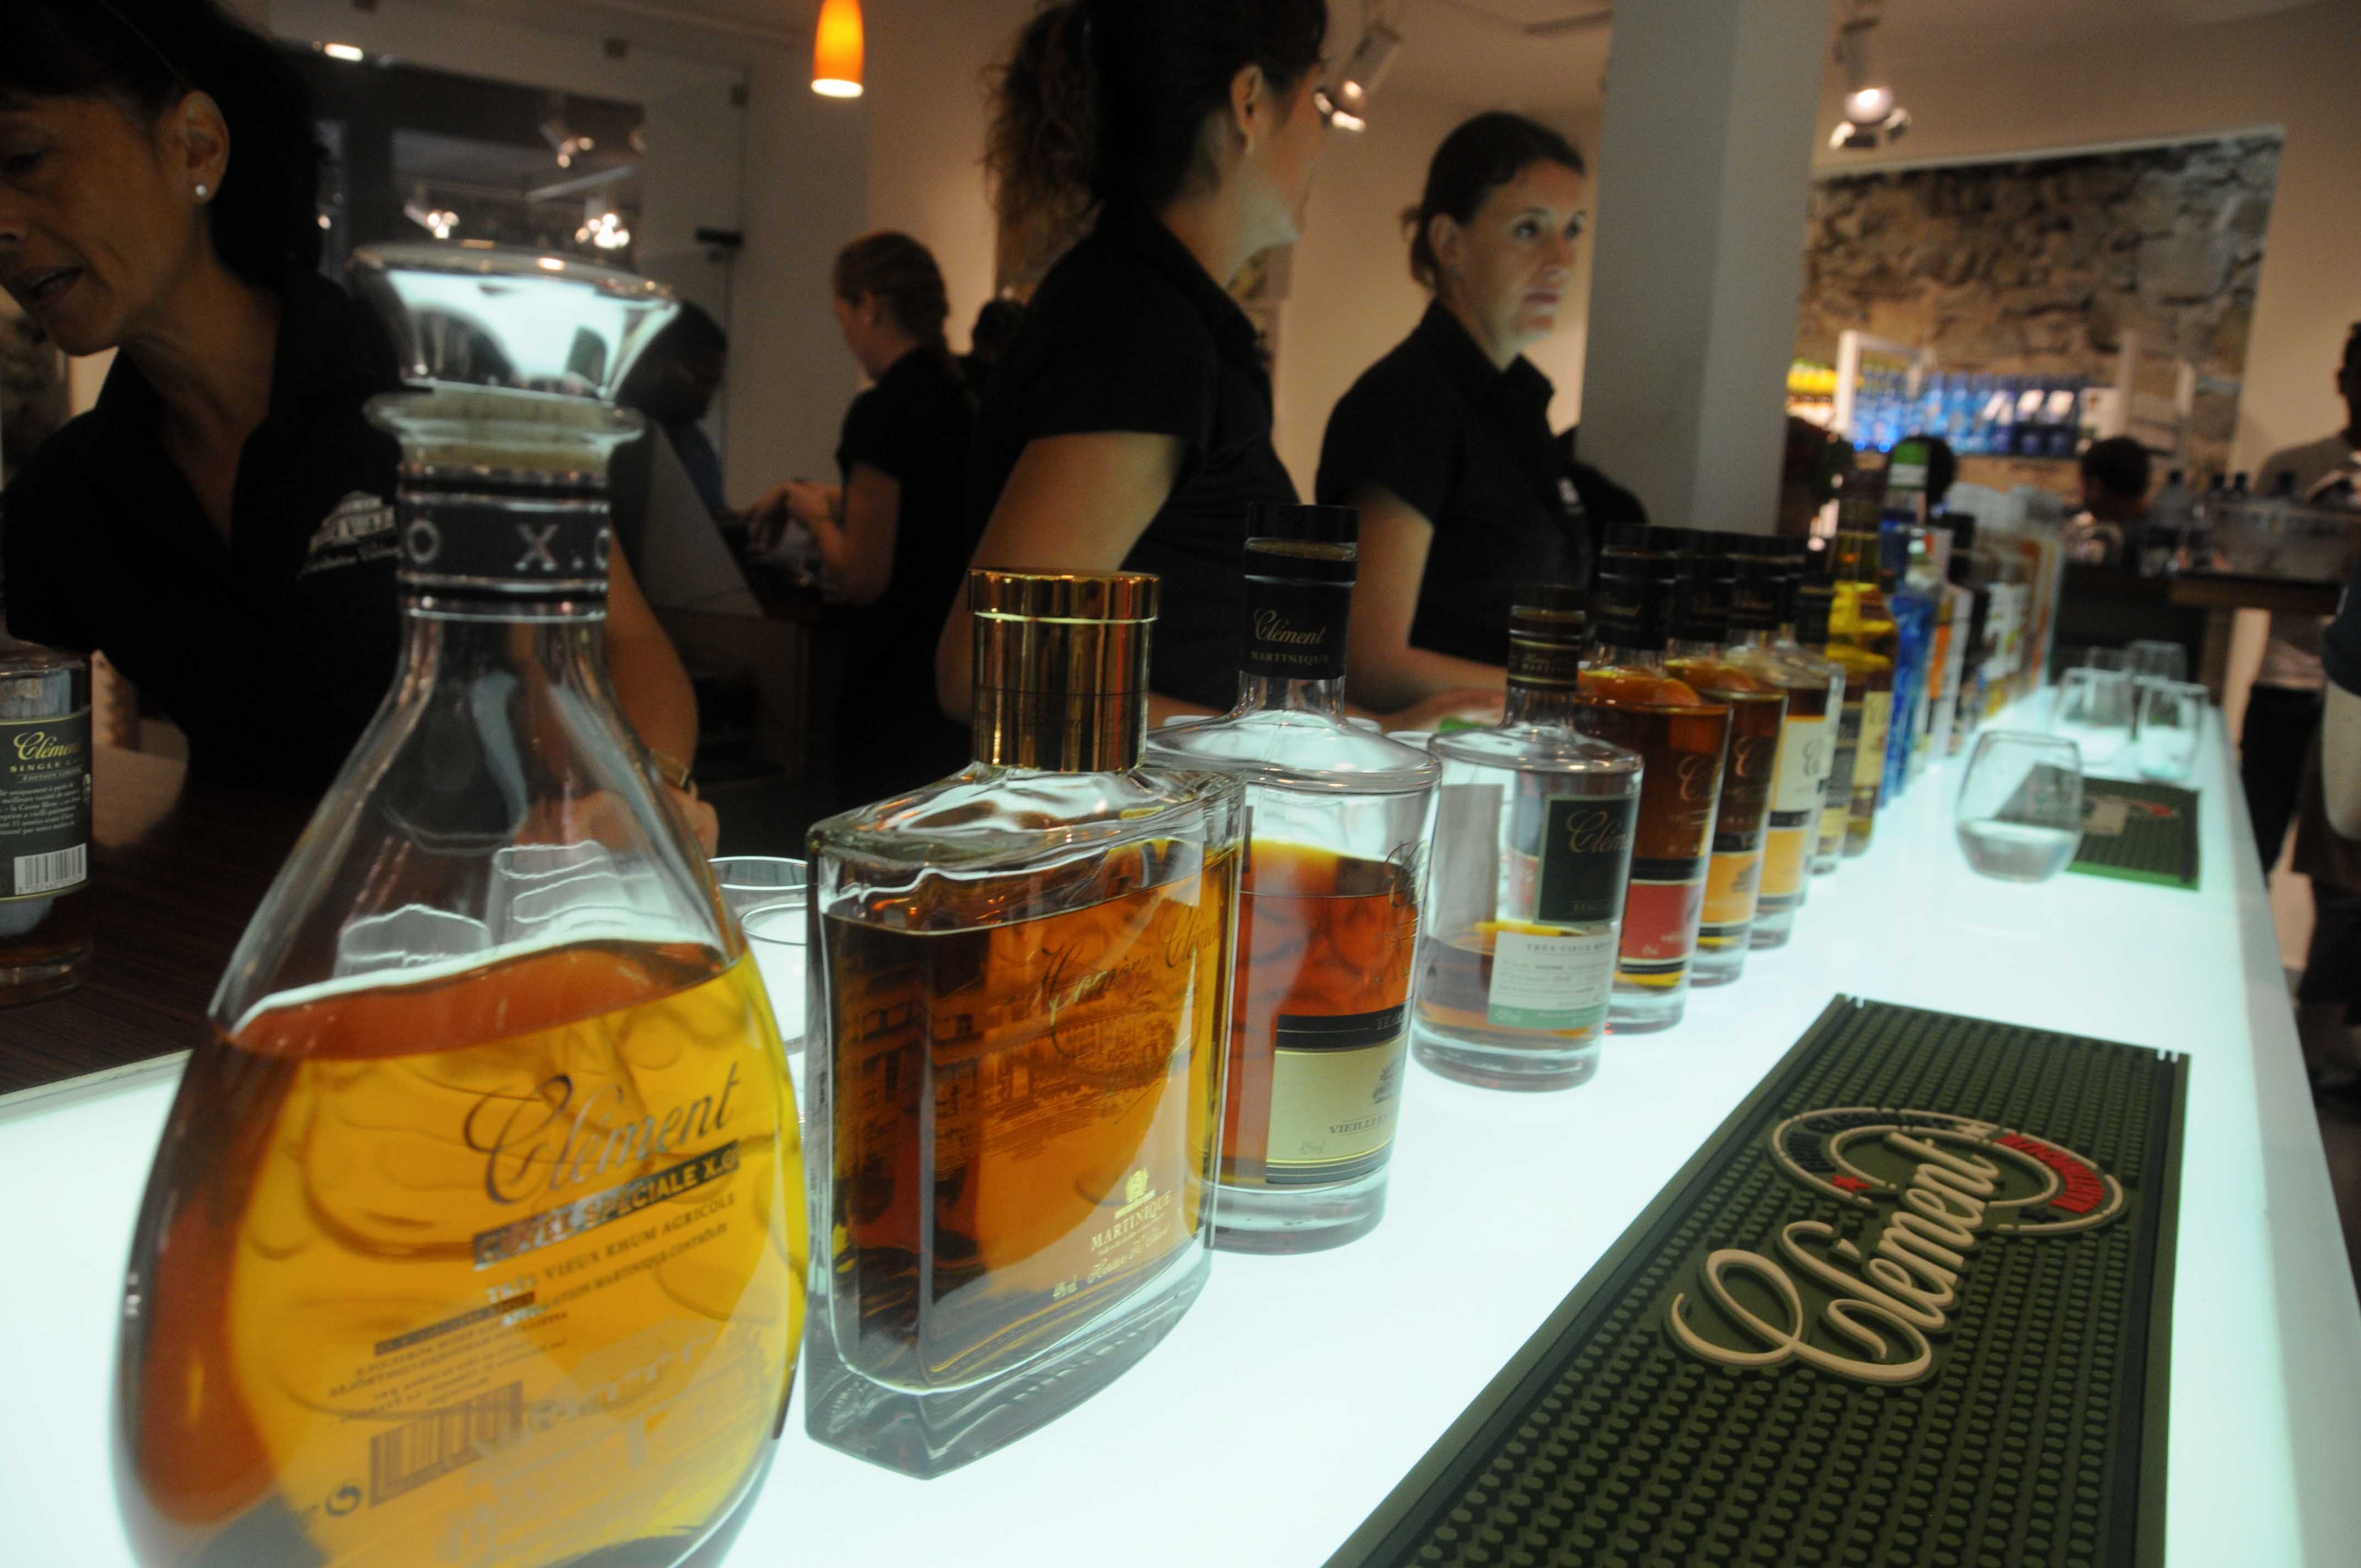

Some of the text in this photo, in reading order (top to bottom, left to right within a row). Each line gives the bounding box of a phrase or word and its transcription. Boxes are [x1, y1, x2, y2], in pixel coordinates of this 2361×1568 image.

[1254, 607, 1326, 644] Clément
[464, 1061, 741, 1205] Clément
[606, 1228, 657, 1257] RHUM
[1090, 1189, 1172, 1251] MARTINIQUE
[1671, 1131, 2000, 1382] Clément
